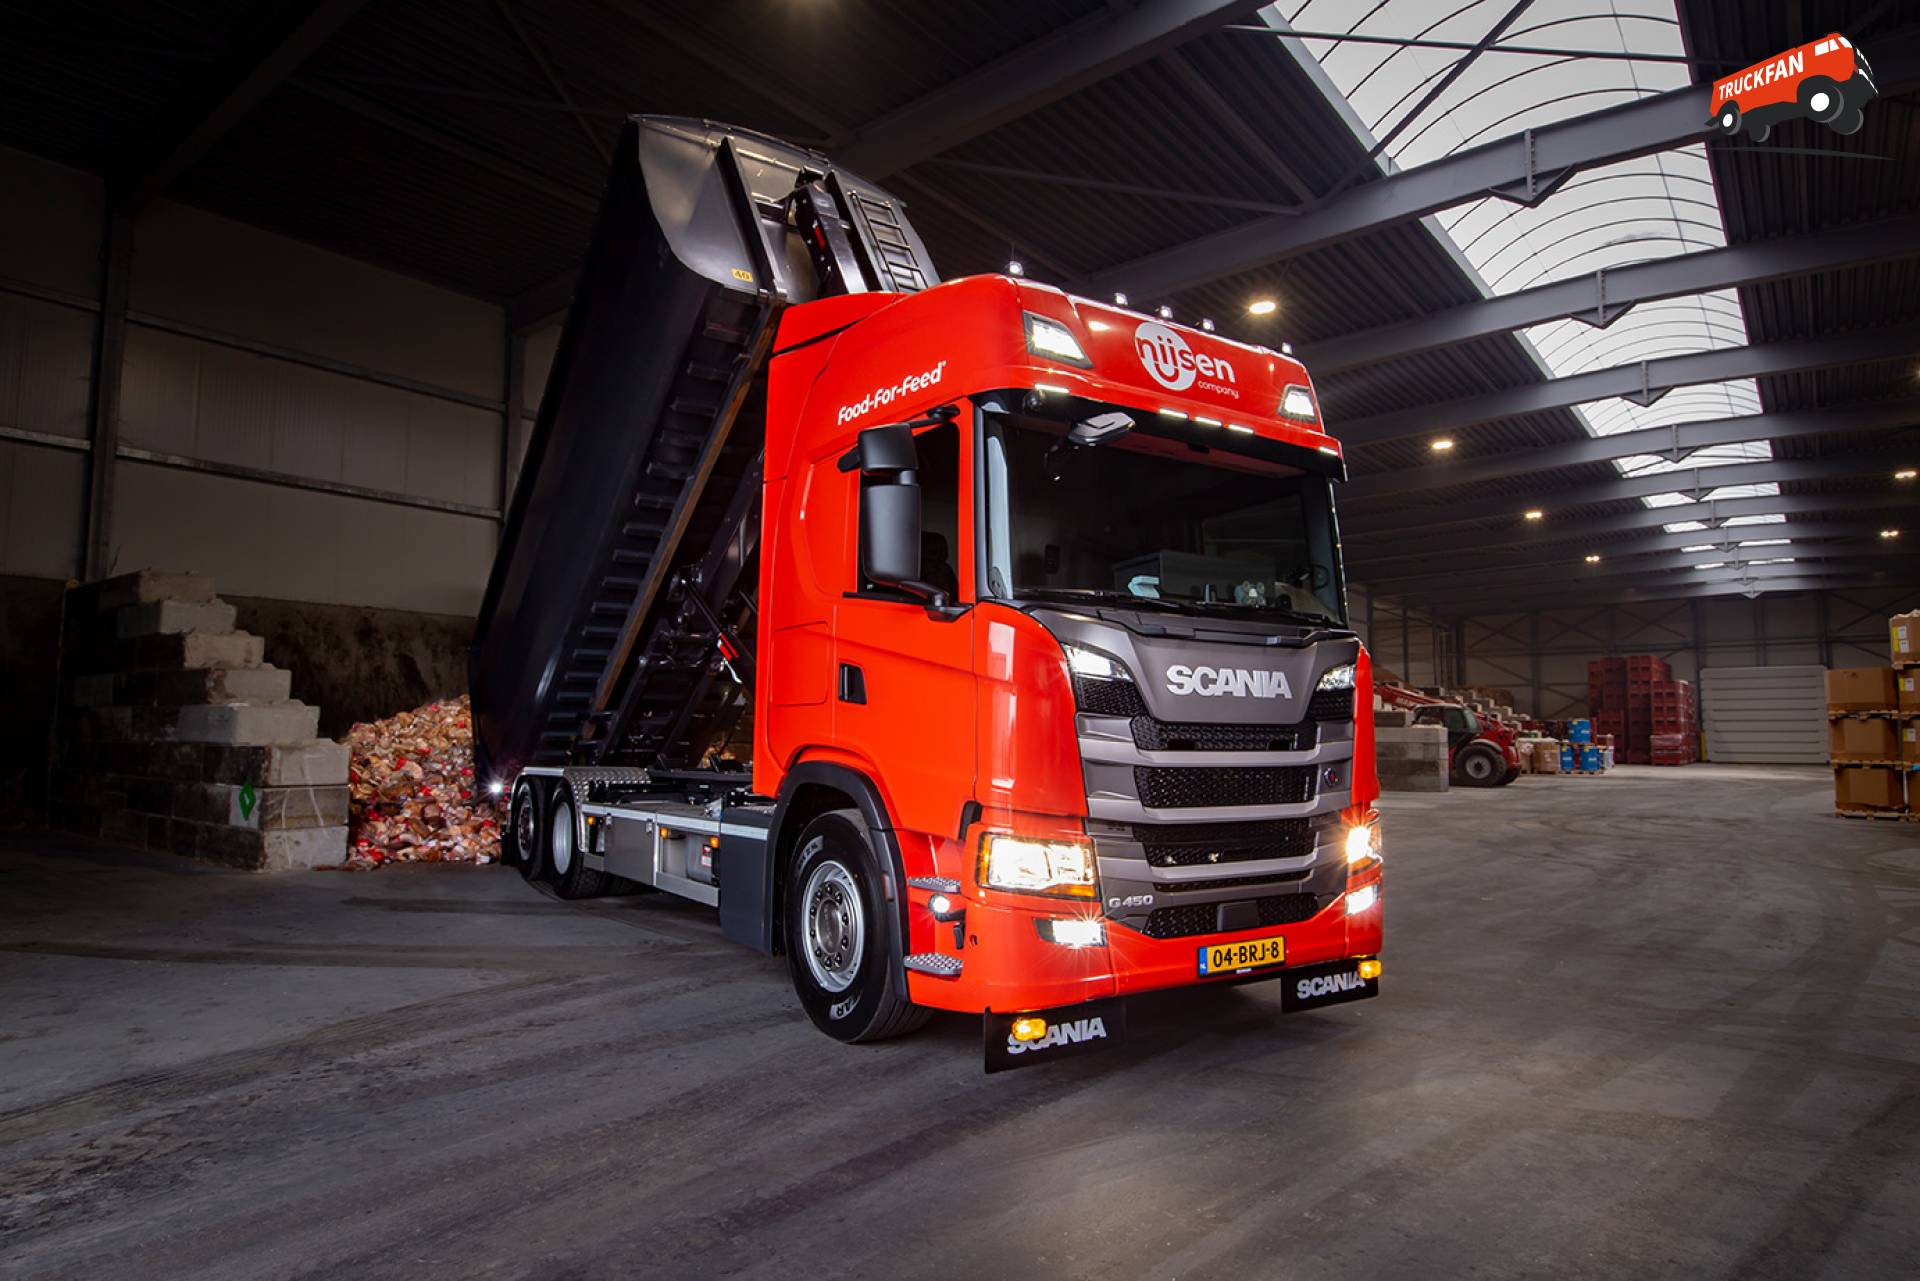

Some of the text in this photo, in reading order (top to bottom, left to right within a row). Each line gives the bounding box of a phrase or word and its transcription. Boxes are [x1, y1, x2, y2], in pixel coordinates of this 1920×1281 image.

[1197, 379, 1240, 399] company
[1166, 664, 1293, 699] SCANIA
[1109, 895, 1154, 908] G 450
[1213, 941, 1279, 968] 04-BRJ-8
[1296, 971, 1367, 1000] SCANIA
